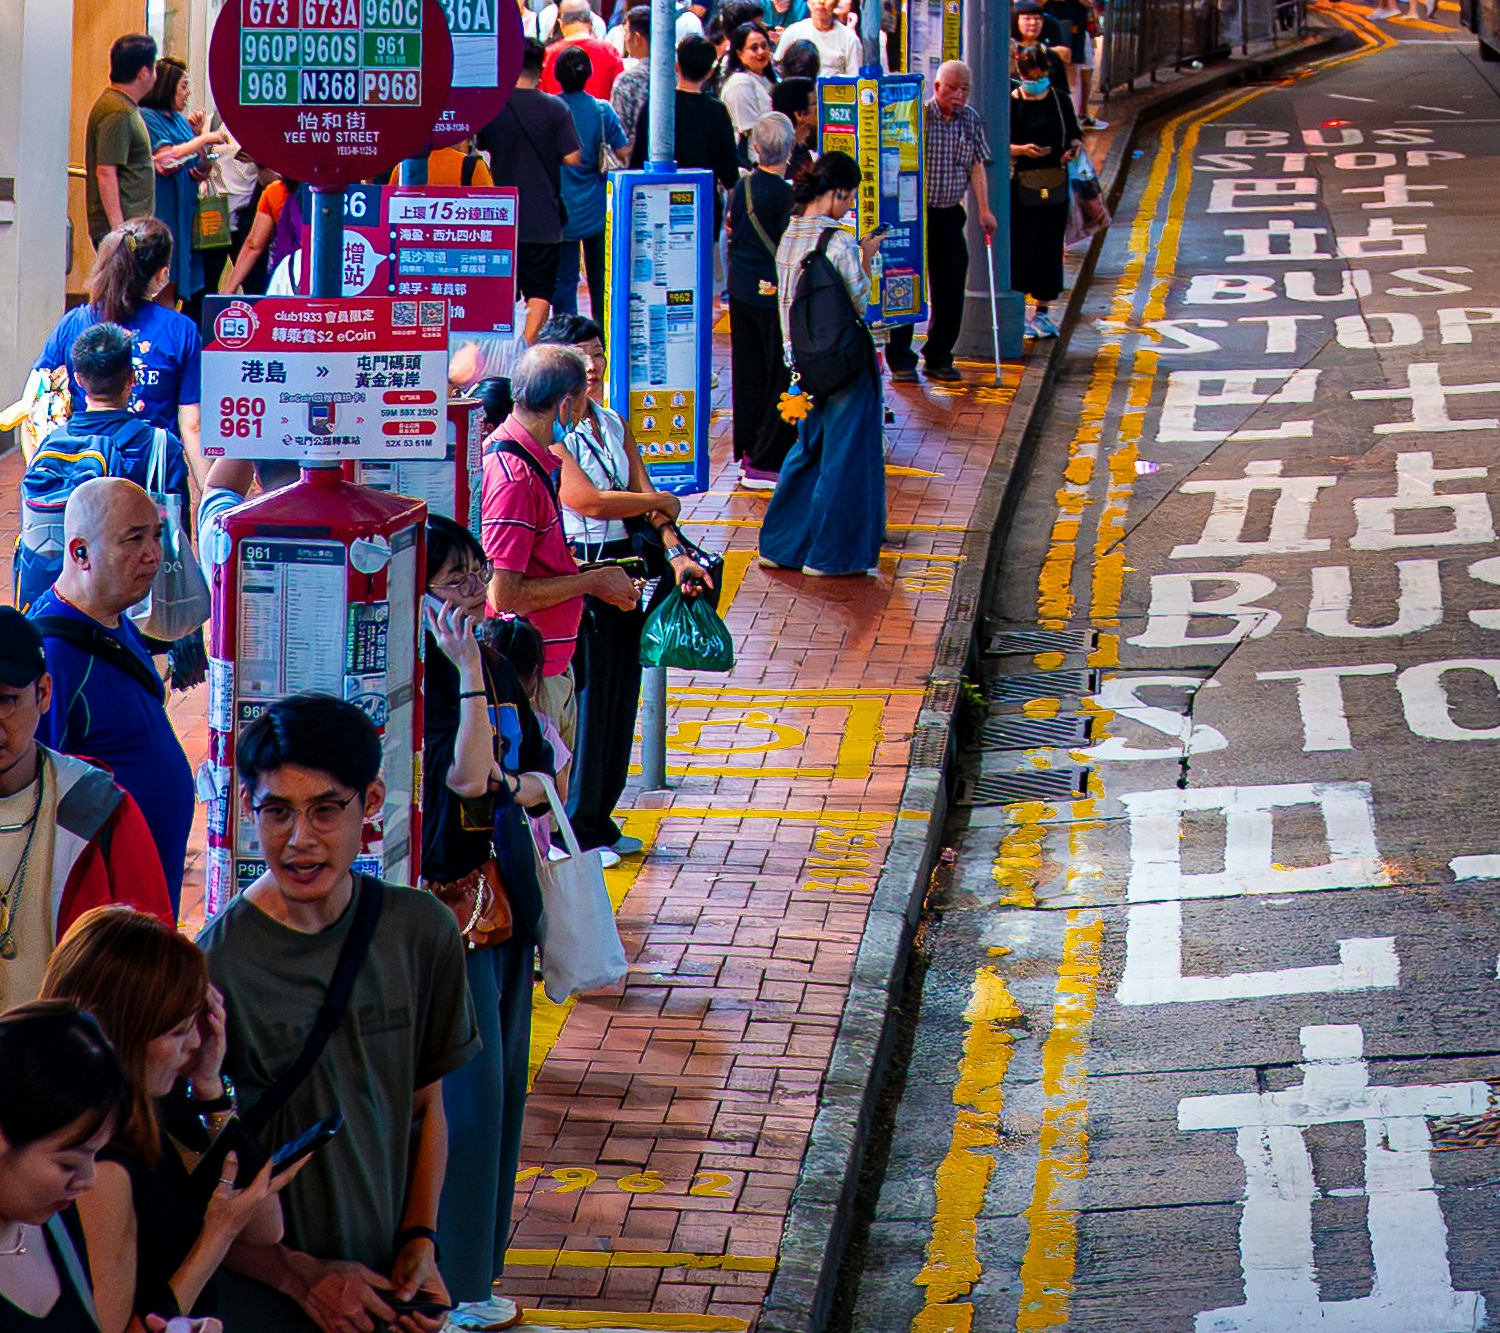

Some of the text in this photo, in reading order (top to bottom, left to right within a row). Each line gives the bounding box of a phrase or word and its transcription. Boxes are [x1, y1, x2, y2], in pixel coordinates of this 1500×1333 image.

[245, 35, 405, 64] 960P 960S 961
[250, 72, 417, 101] 968 N368 P968
[297, 111, 366, 131] 怡和街
[284, 132, 380, 143] YEE WO STREET
[1225, 128, 1434, 147] BUS
[1193, 150, 1466, 172] STOP
[1206, 174, 1448, 213] 巴士
[1224, 218, 1427, 262] 站
[1189, 266, 1475, 305] BUS
[274, 312, 322, 323] club1933
[325, 309, 374, 323] 會員限定
[272, 328, 376, 343] 轉乘賞$2 eCoin
[242, 355, 421, 383] 港島 屯門碼頭
[356, 373, 419, 388] 黃金海岸
[220, 397, 265, 417] 960
[220, 418, 262, 438] 961
[1170, 452, 1499, 559] 站
[247, 547, 270, 559] 961
